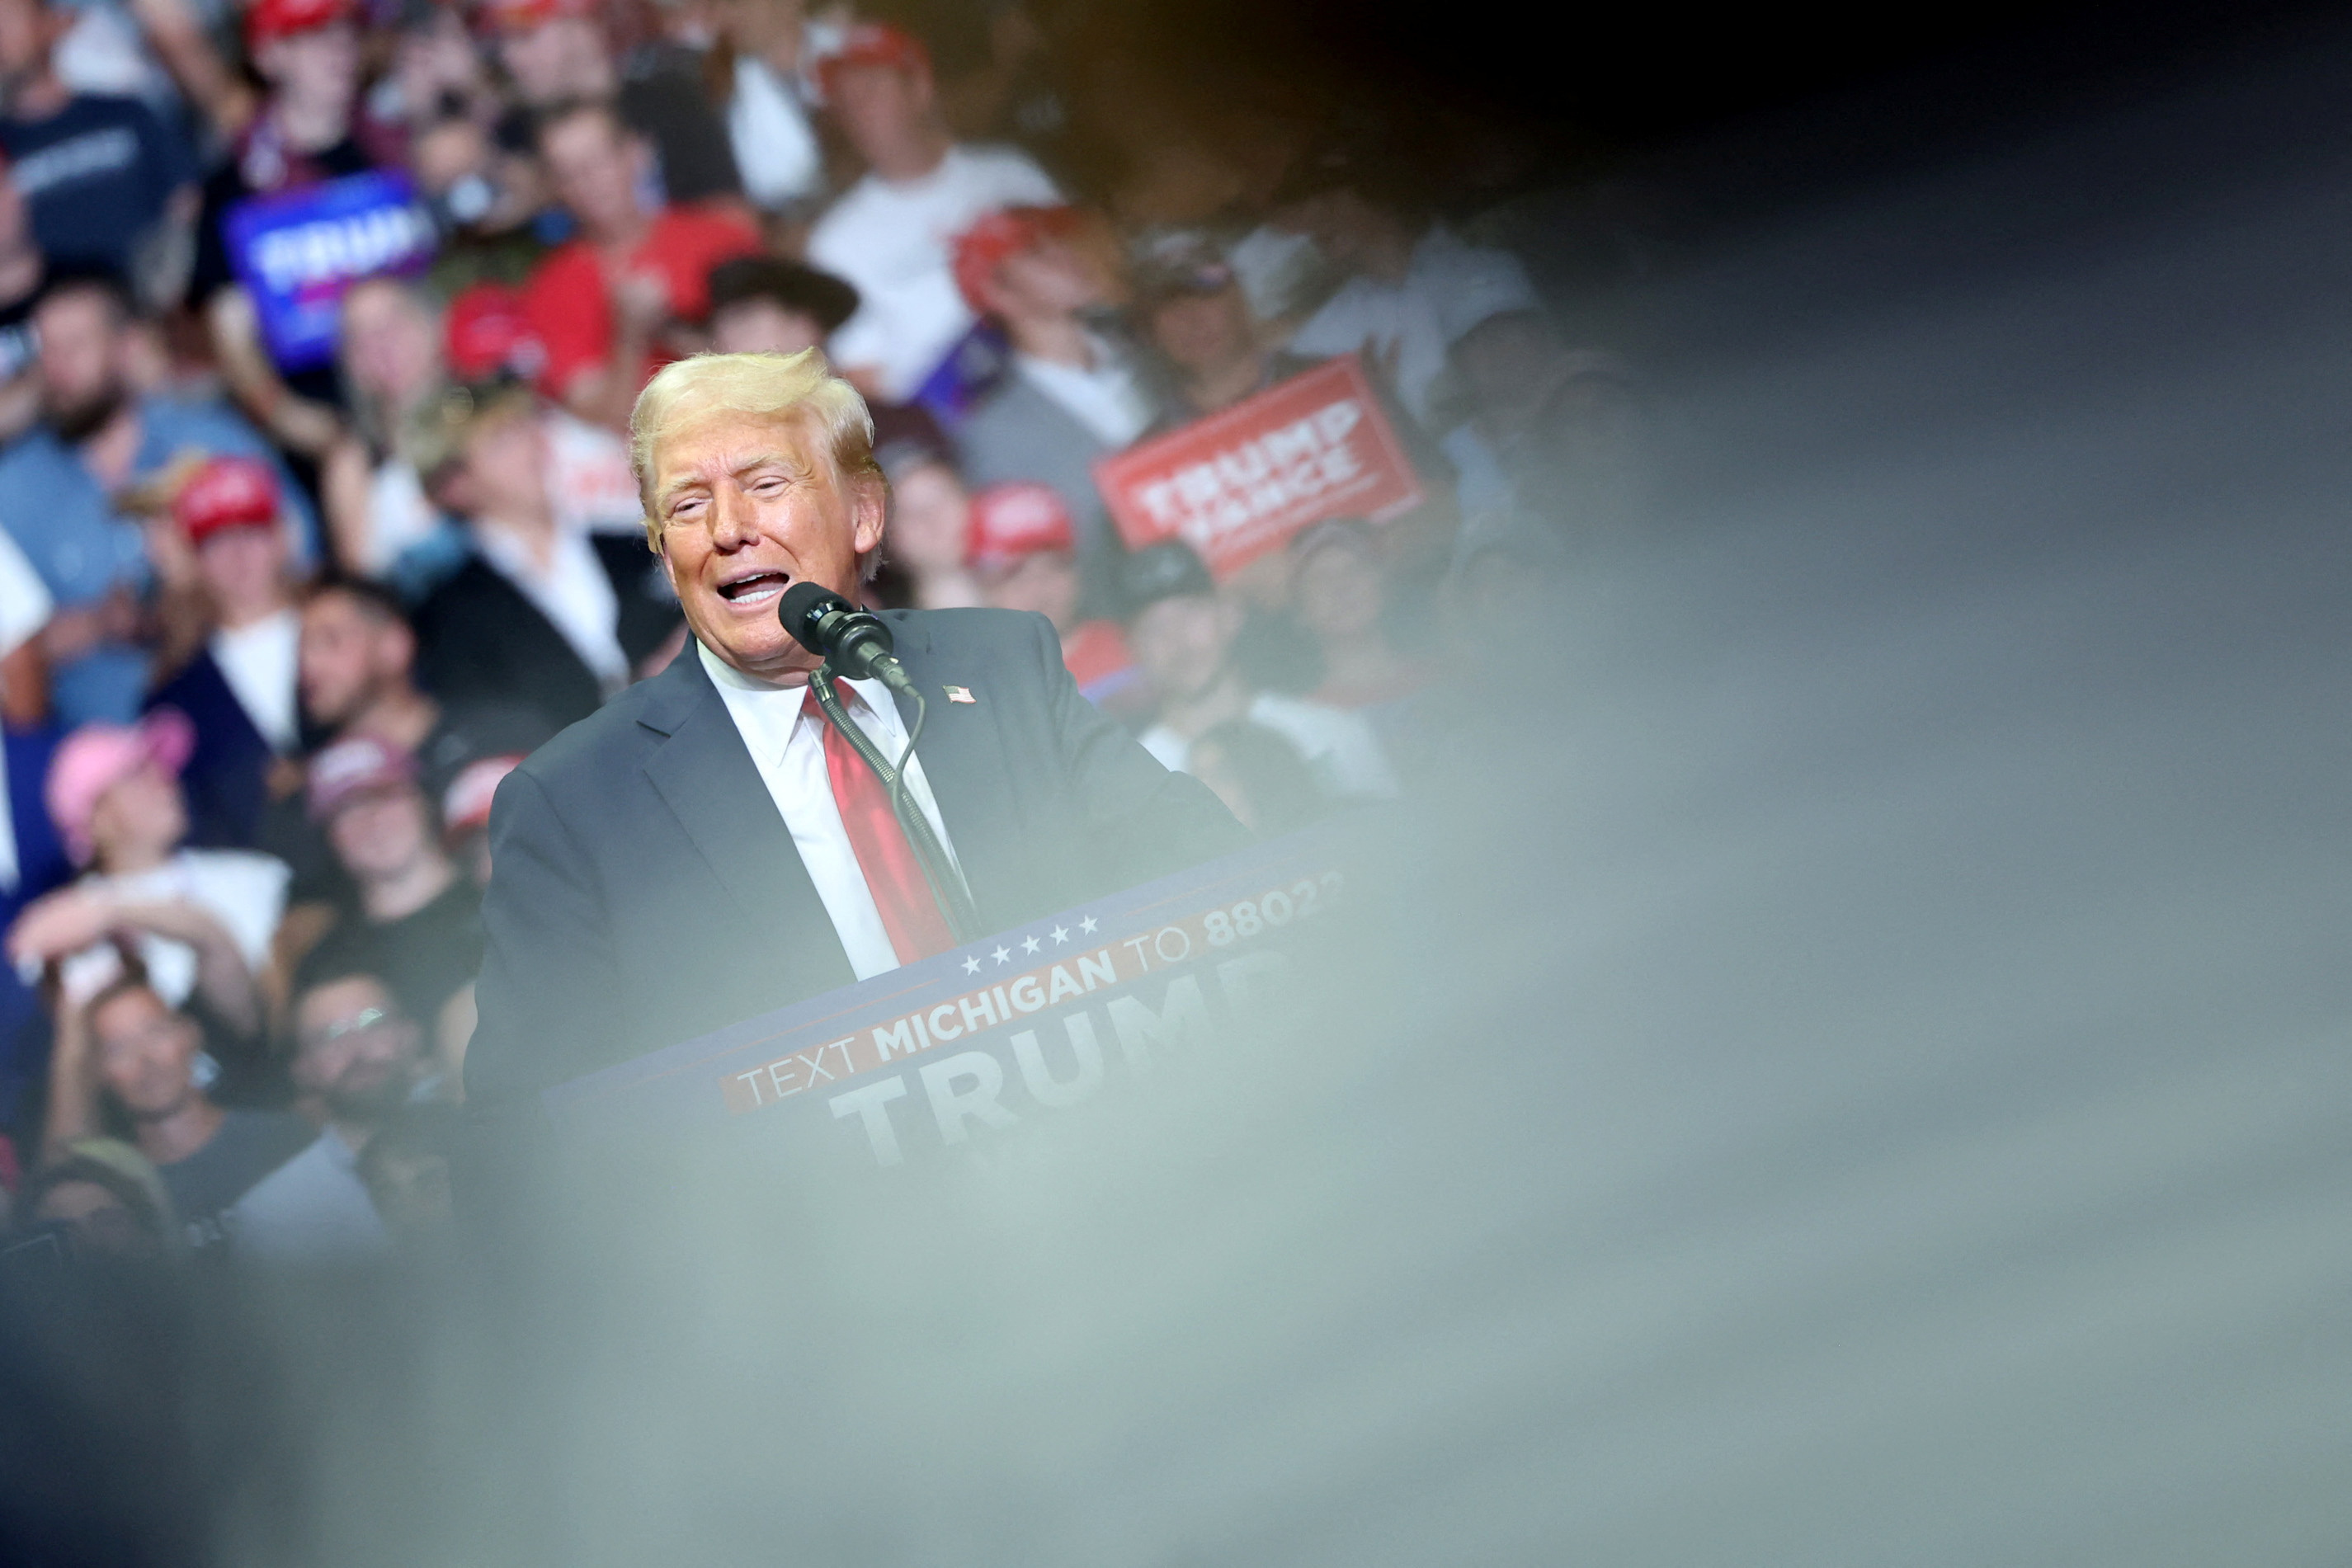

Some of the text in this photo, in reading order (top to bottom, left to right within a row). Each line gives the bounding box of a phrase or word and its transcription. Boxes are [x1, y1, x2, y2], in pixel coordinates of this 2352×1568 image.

[1132, 398, 1362, 528] TRUMP
[737, 1037, 855, 1105] TEXT
[872, 949, 1117, 1062] MICHIGAN
[1124, 926, 1190, 972] TO
